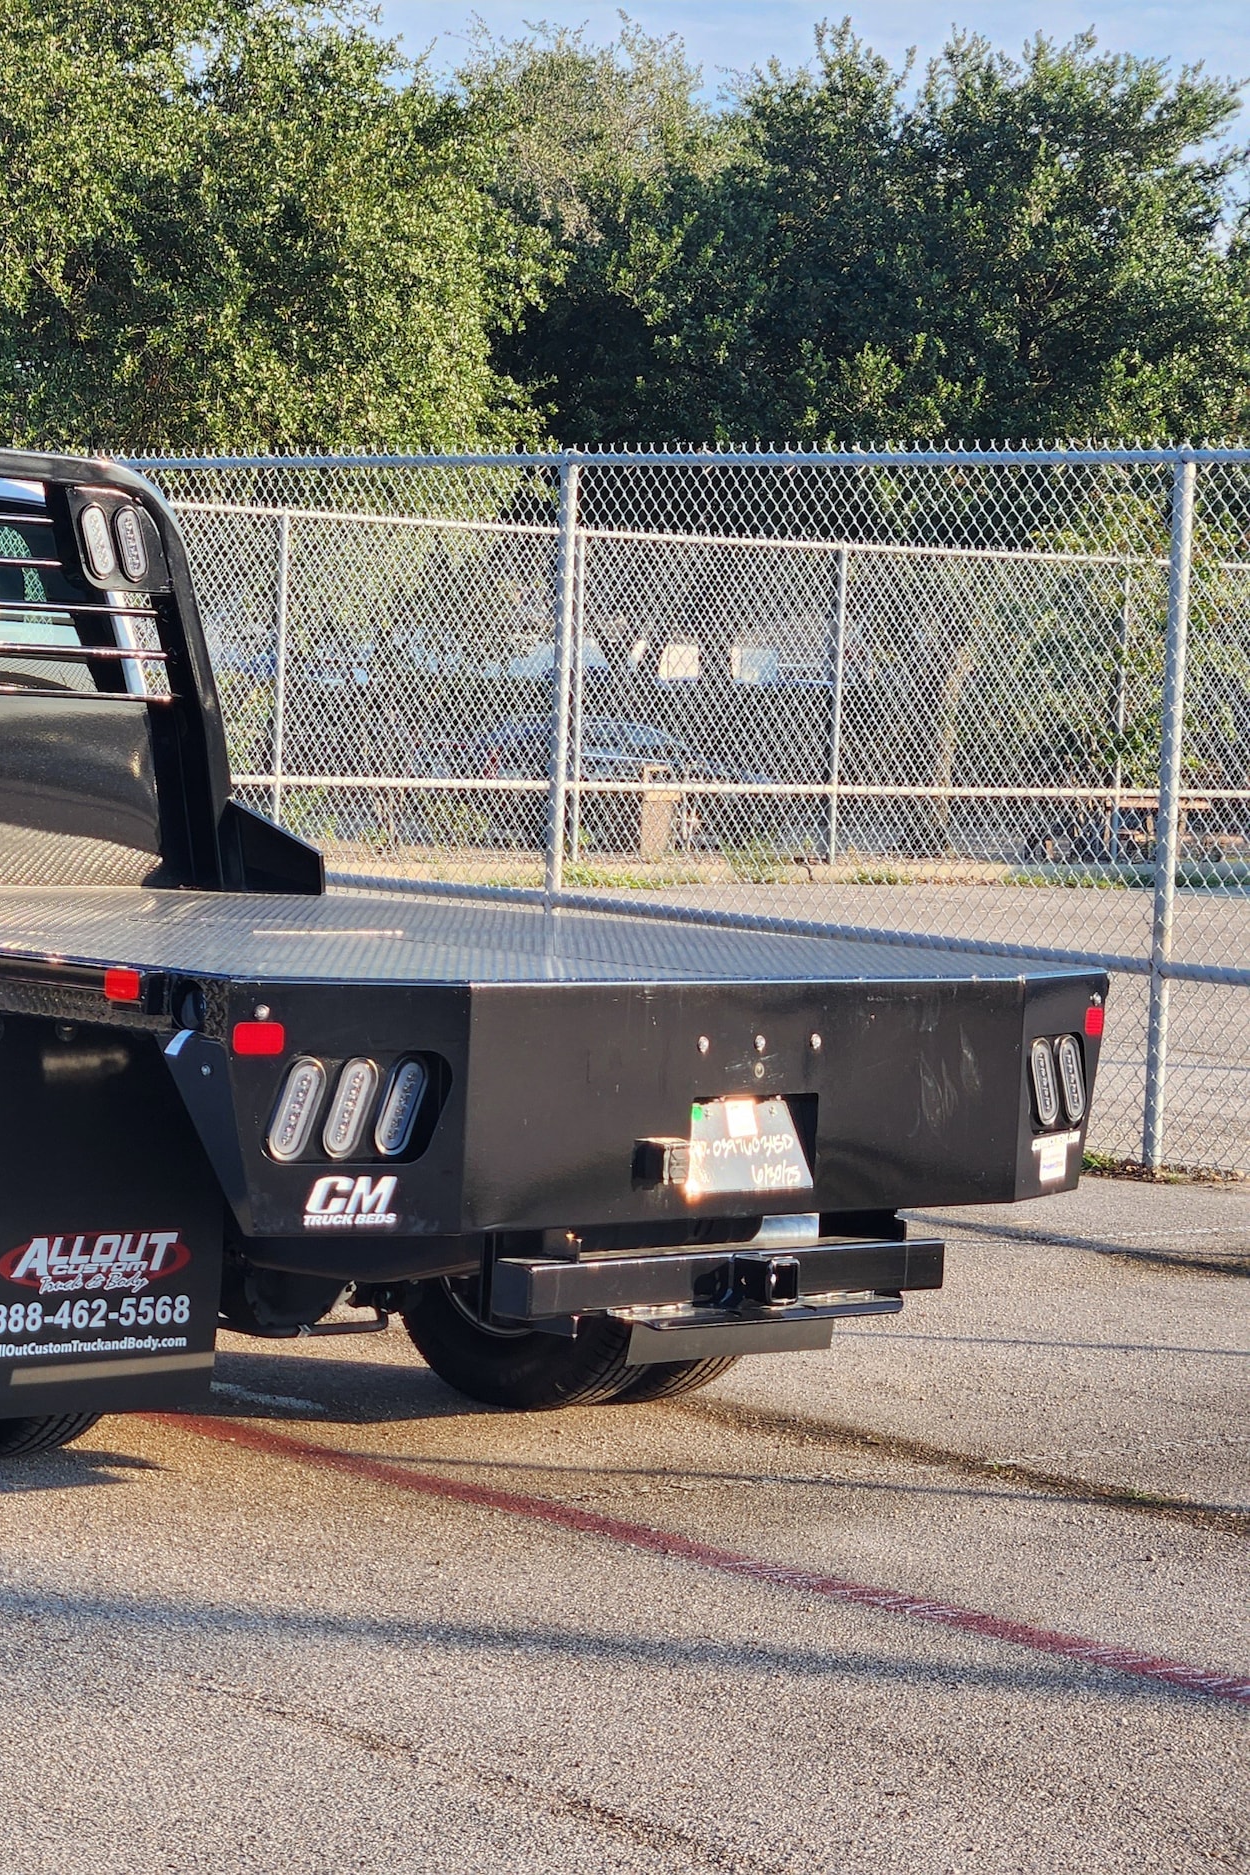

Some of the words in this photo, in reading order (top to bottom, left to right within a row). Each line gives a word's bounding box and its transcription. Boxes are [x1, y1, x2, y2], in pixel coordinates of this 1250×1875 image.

[305, 1175, 398, 1214] CM
[303, 1213, 354, 1226] TRUCK
[354, 1212, 398, 1225] BEDS
[10, 1231, 179, 1279] ALLOUT
[51, 1260, 149, 1276] CUSTOM
[39, 1274, 83, 1295] Truck
[104, 1270, 150, 1294] Body
